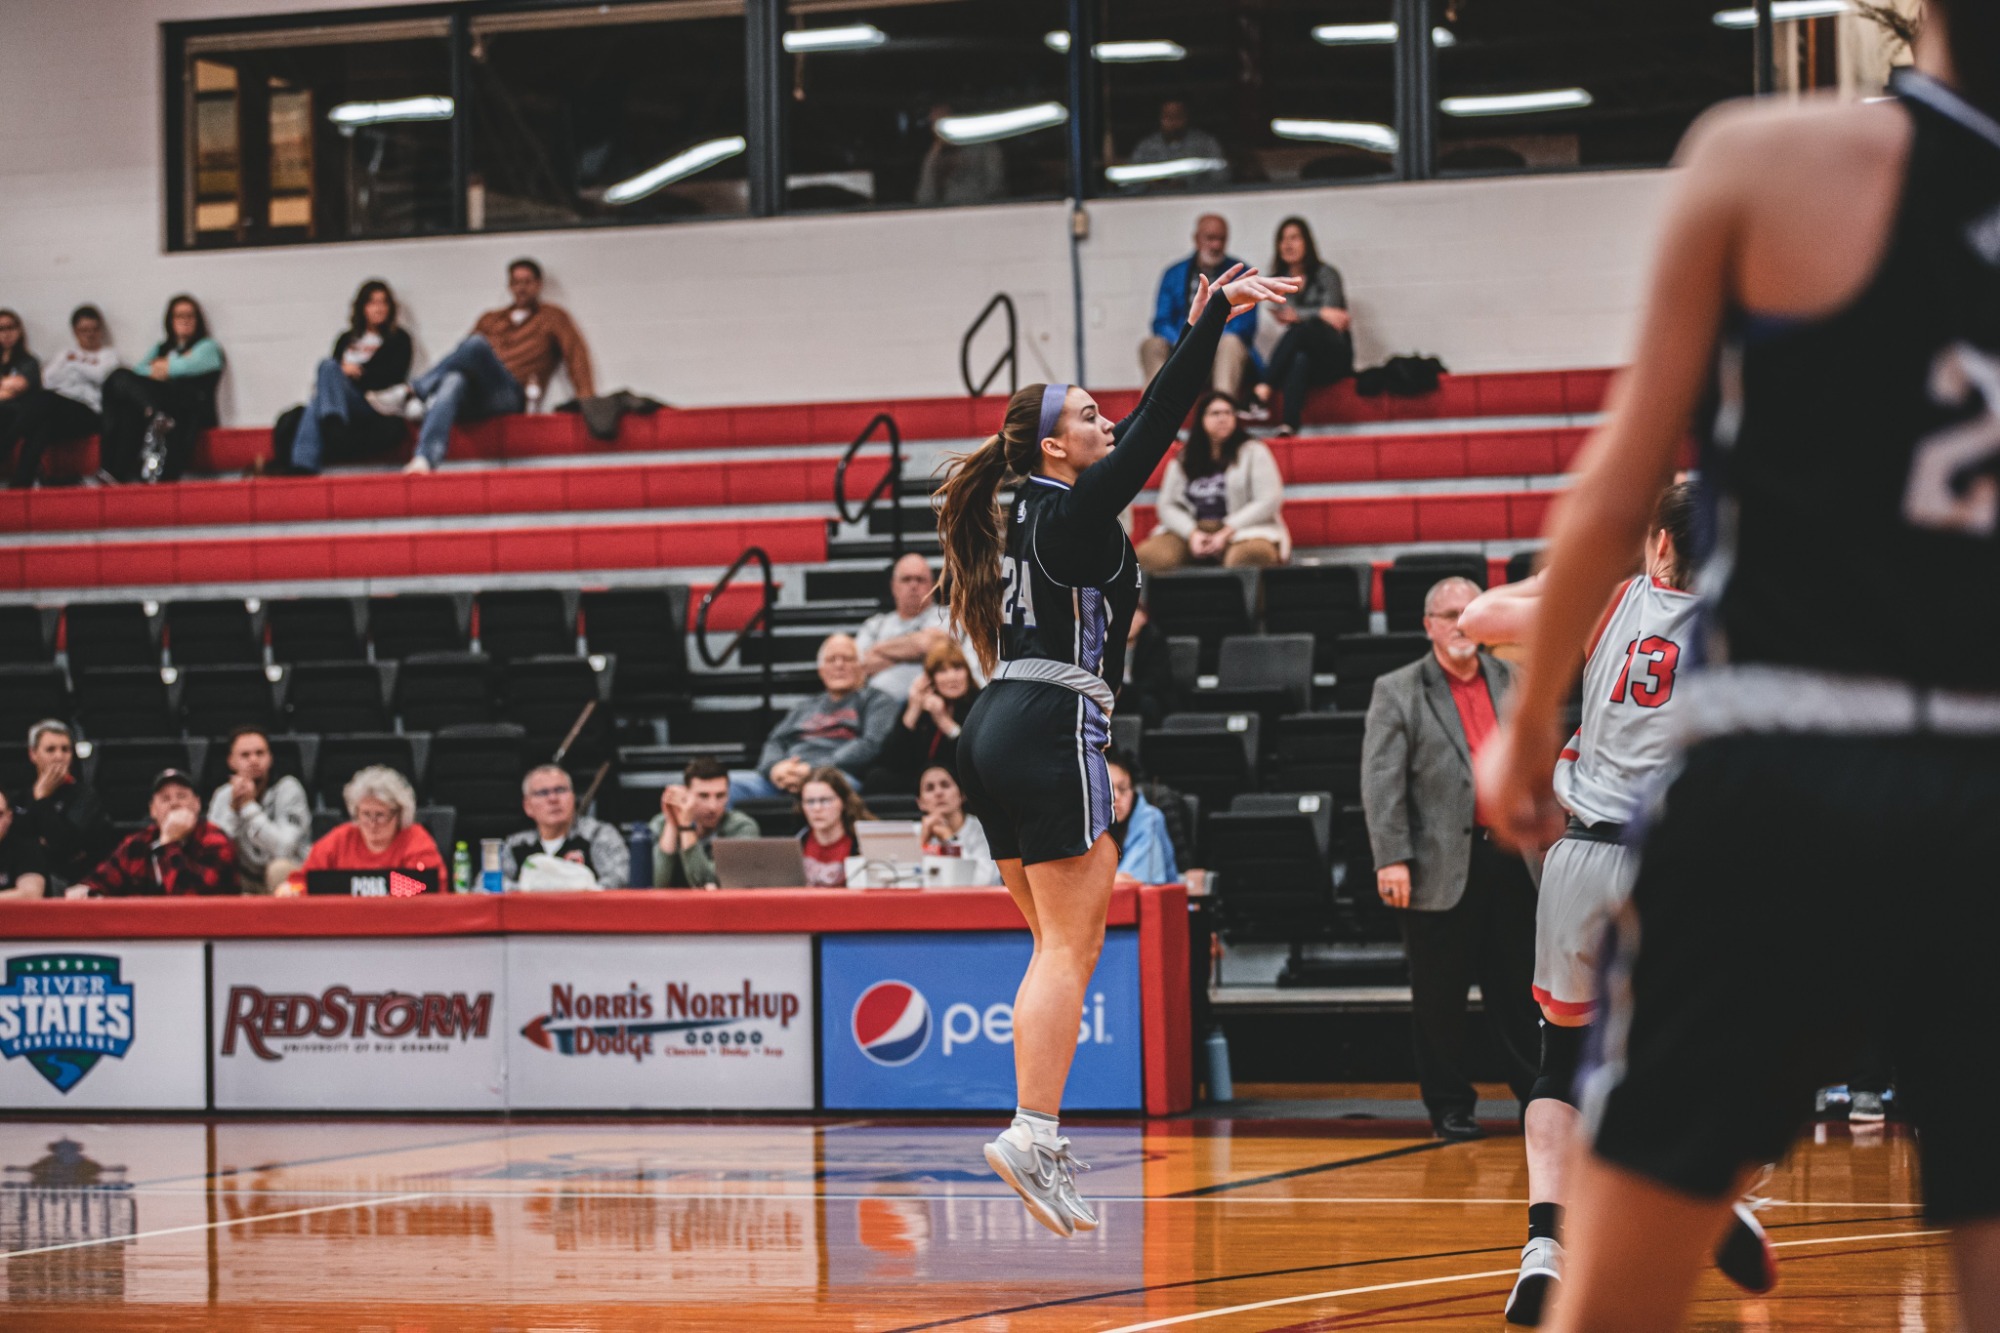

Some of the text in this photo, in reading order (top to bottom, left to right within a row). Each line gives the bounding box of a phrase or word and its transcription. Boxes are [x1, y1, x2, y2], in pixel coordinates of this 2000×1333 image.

[1001, 555, 1037, 629] 24
[1608, 632, 1681, 708] 13
[23, 976, 105, 995] RIVER
[0, 994, 131, 1041] STATES
